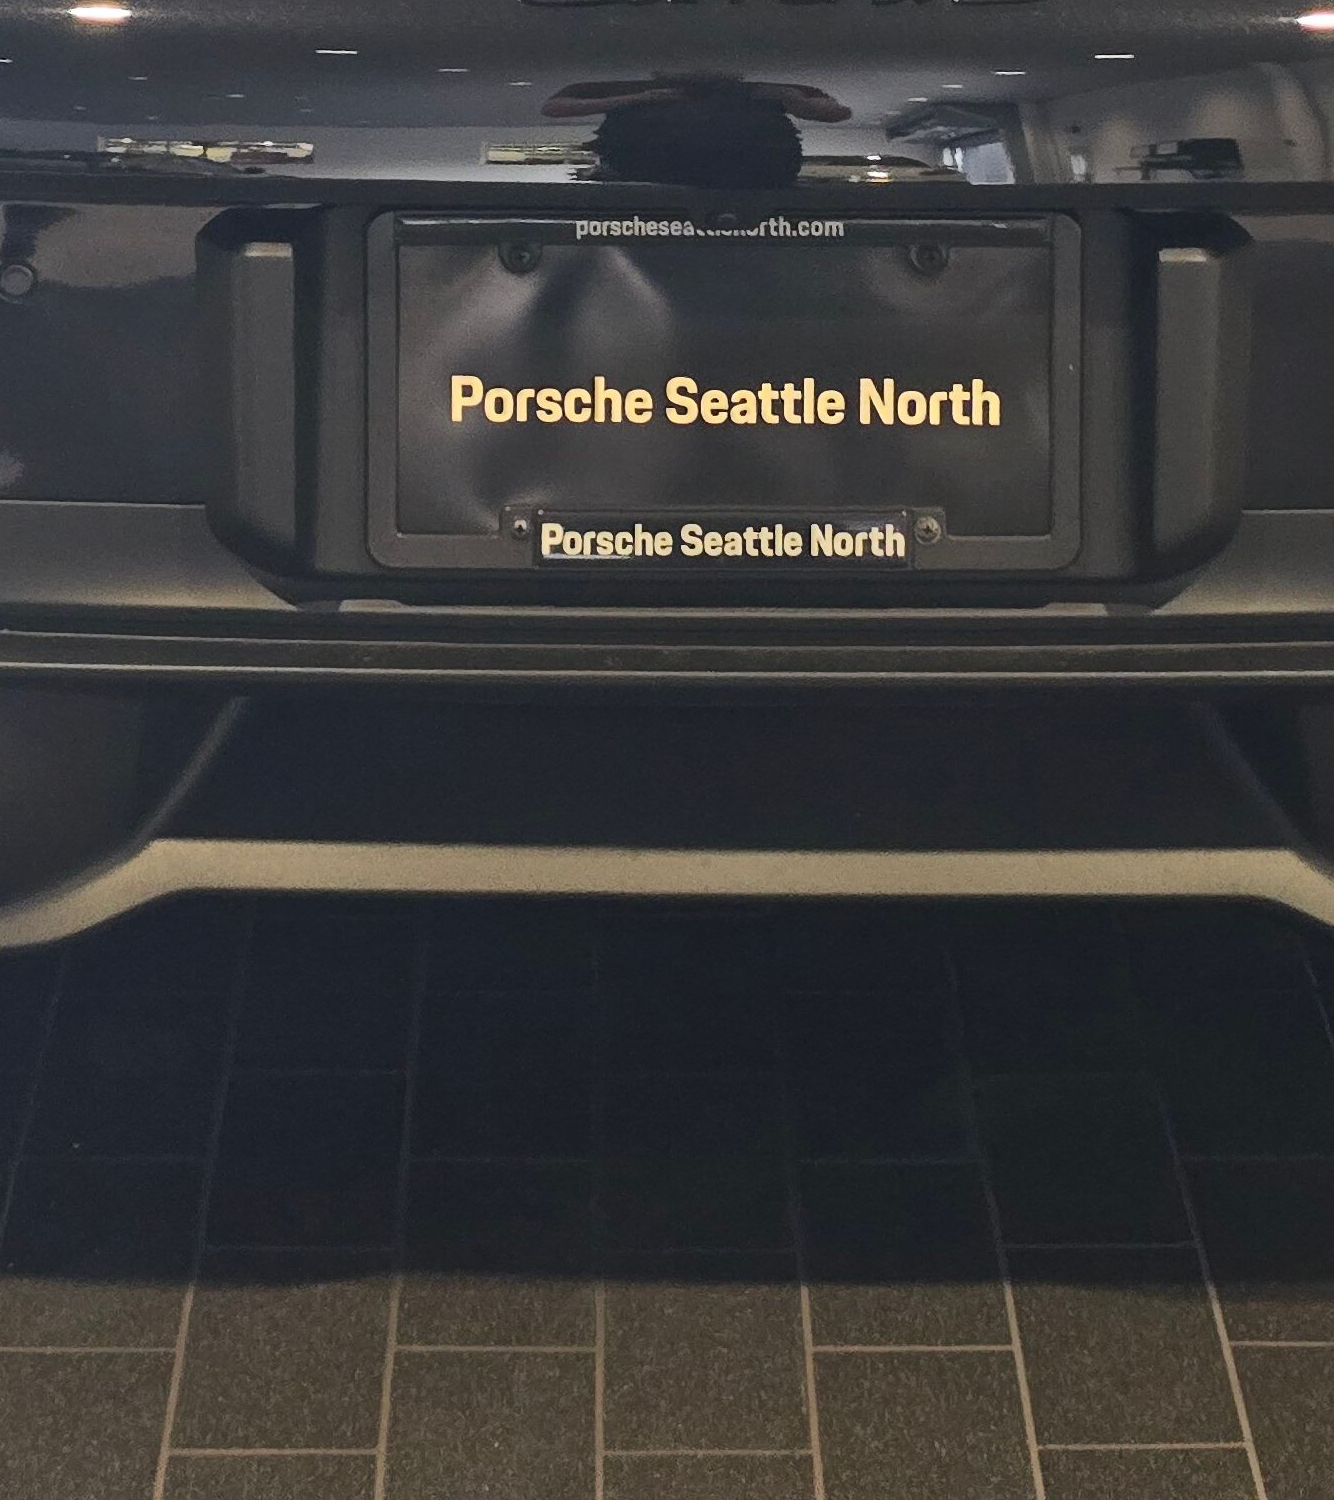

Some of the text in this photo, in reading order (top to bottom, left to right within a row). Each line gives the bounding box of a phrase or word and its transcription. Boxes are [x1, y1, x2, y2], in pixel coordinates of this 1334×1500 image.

[576, 216, 844, 240] porschesearth.com
[450, 375, 1001, 426] Porsche Seattle North
[540, 523, 906, 557] Porsche Seattle North
